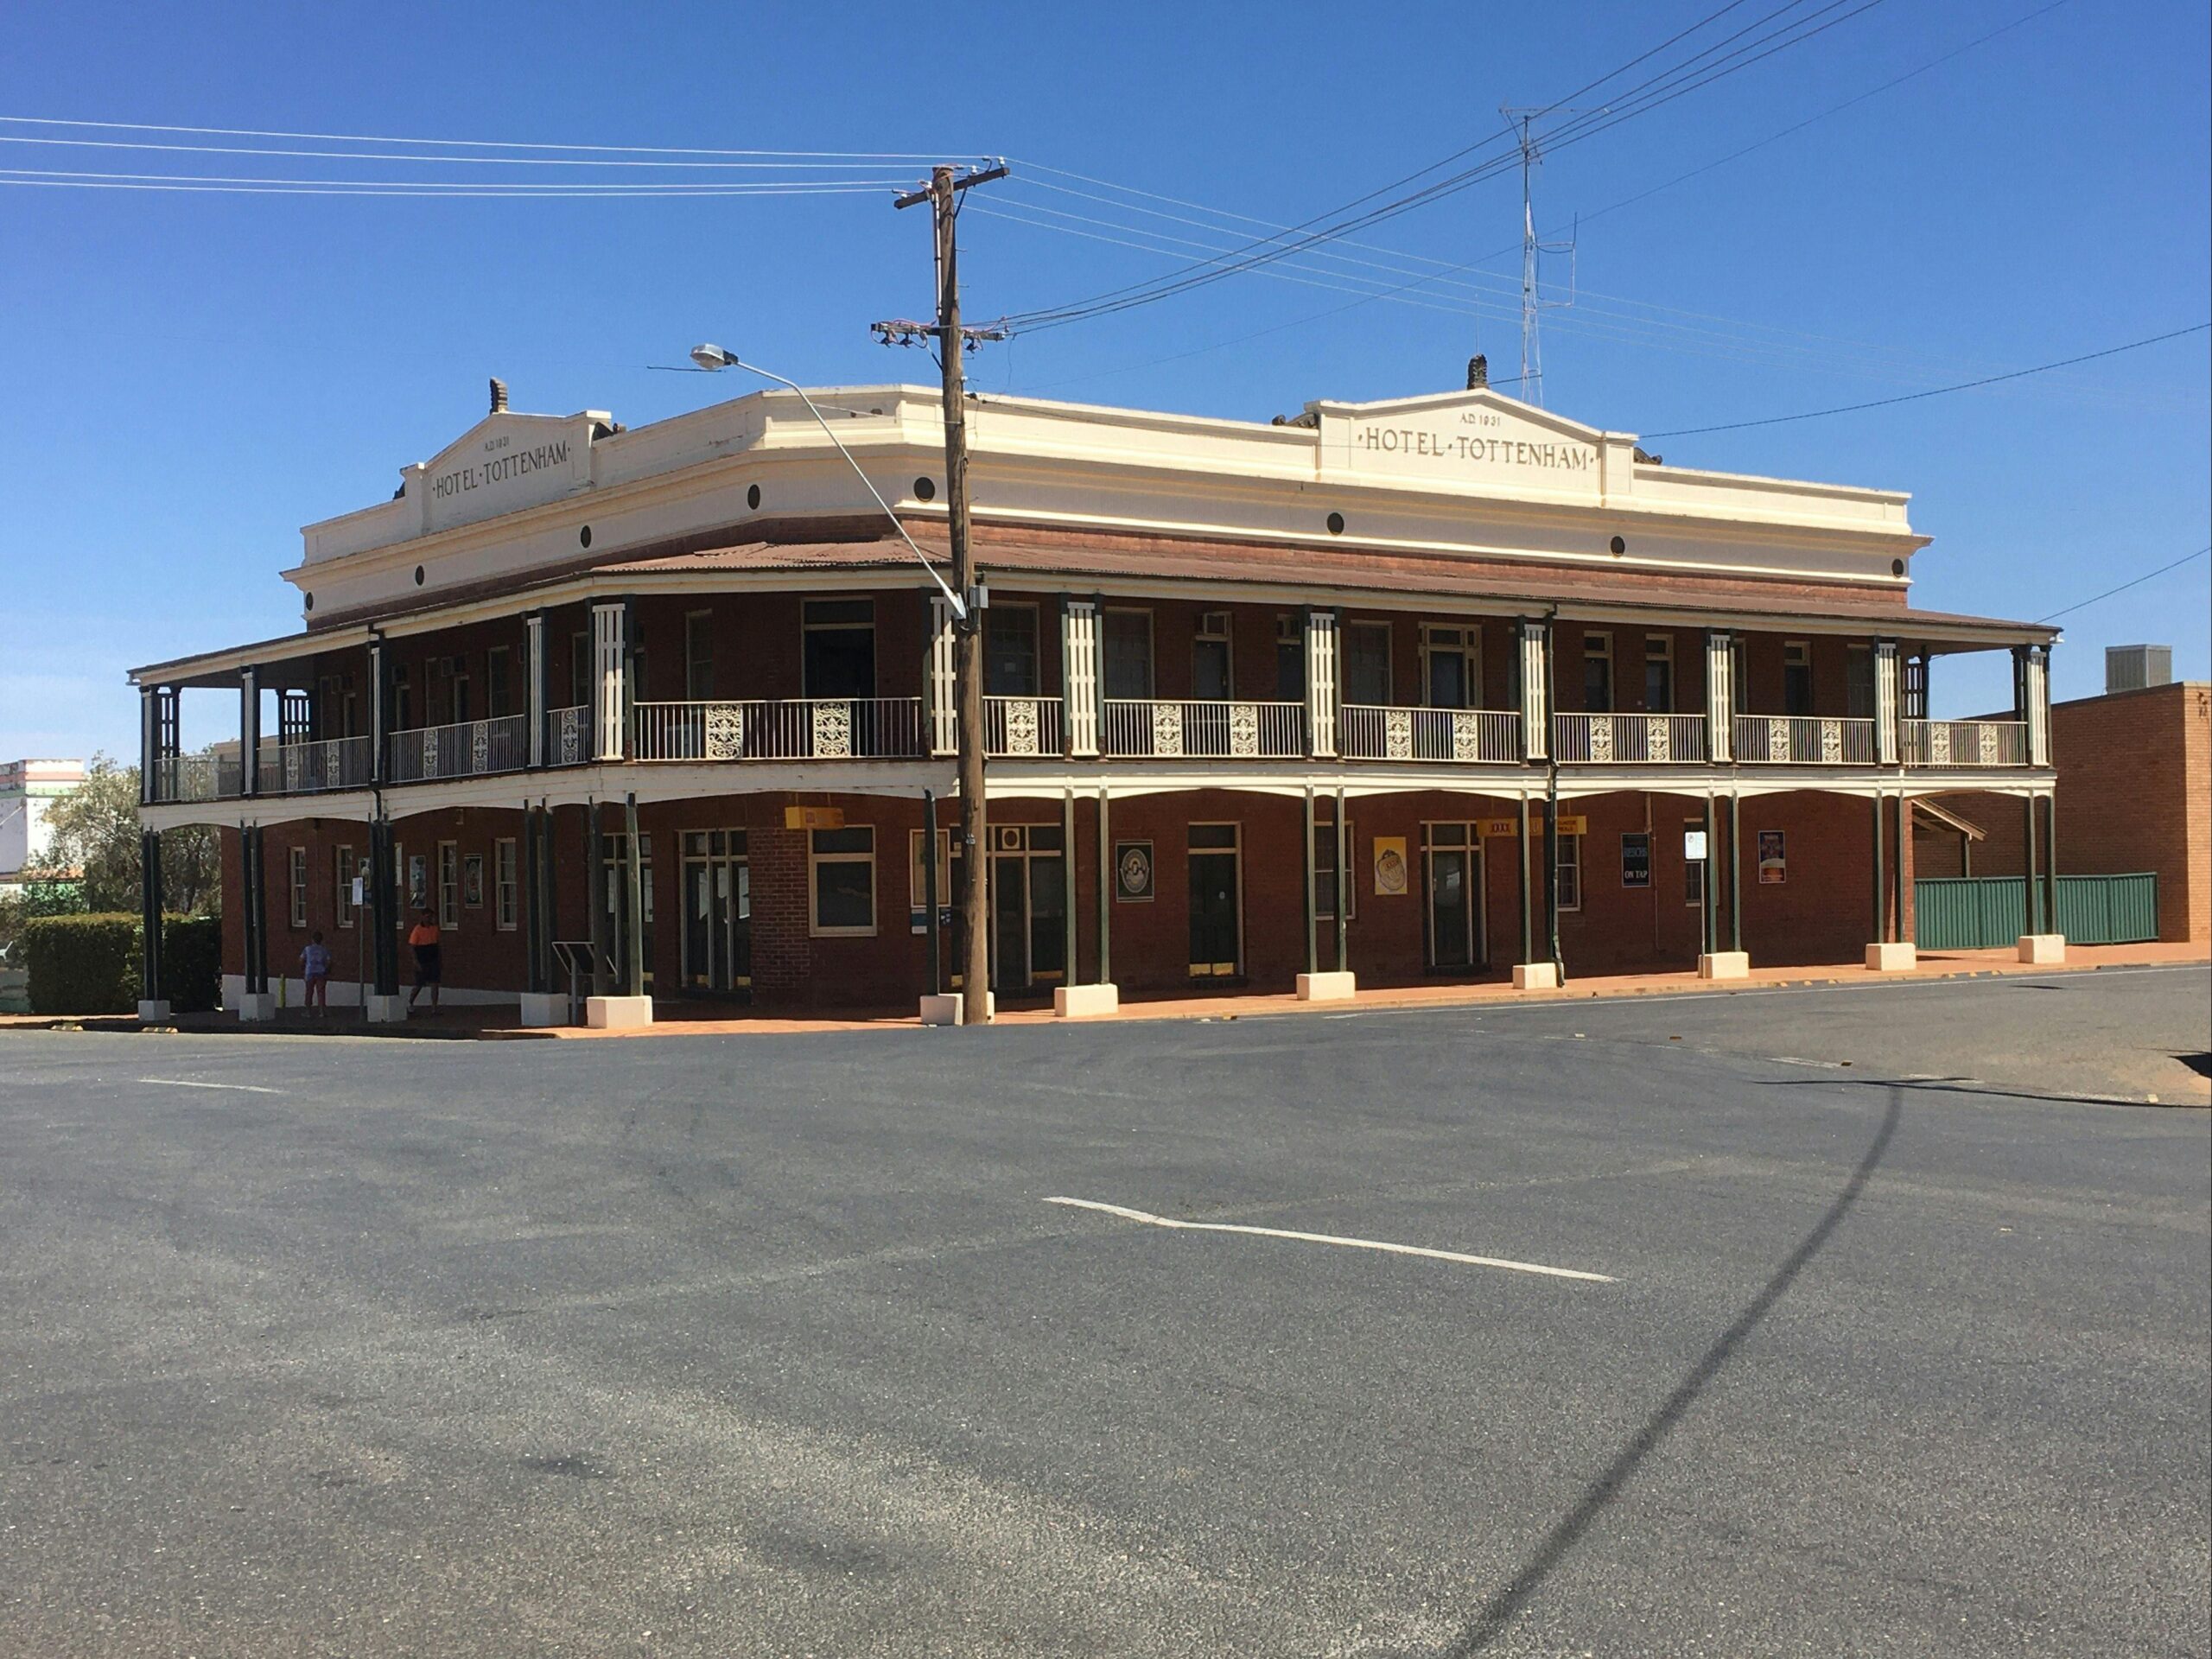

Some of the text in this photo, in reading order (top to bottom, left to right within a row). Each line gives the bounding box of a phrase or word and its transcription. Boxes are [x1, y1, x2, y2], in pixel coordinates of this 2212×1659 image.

[1479, 414, 1501, 427] 1931
[436, 440, 567, 499] HOTEL TOTTENHAM
[1365, 427, 1587, 470] HOTEL TOTTENHAM
